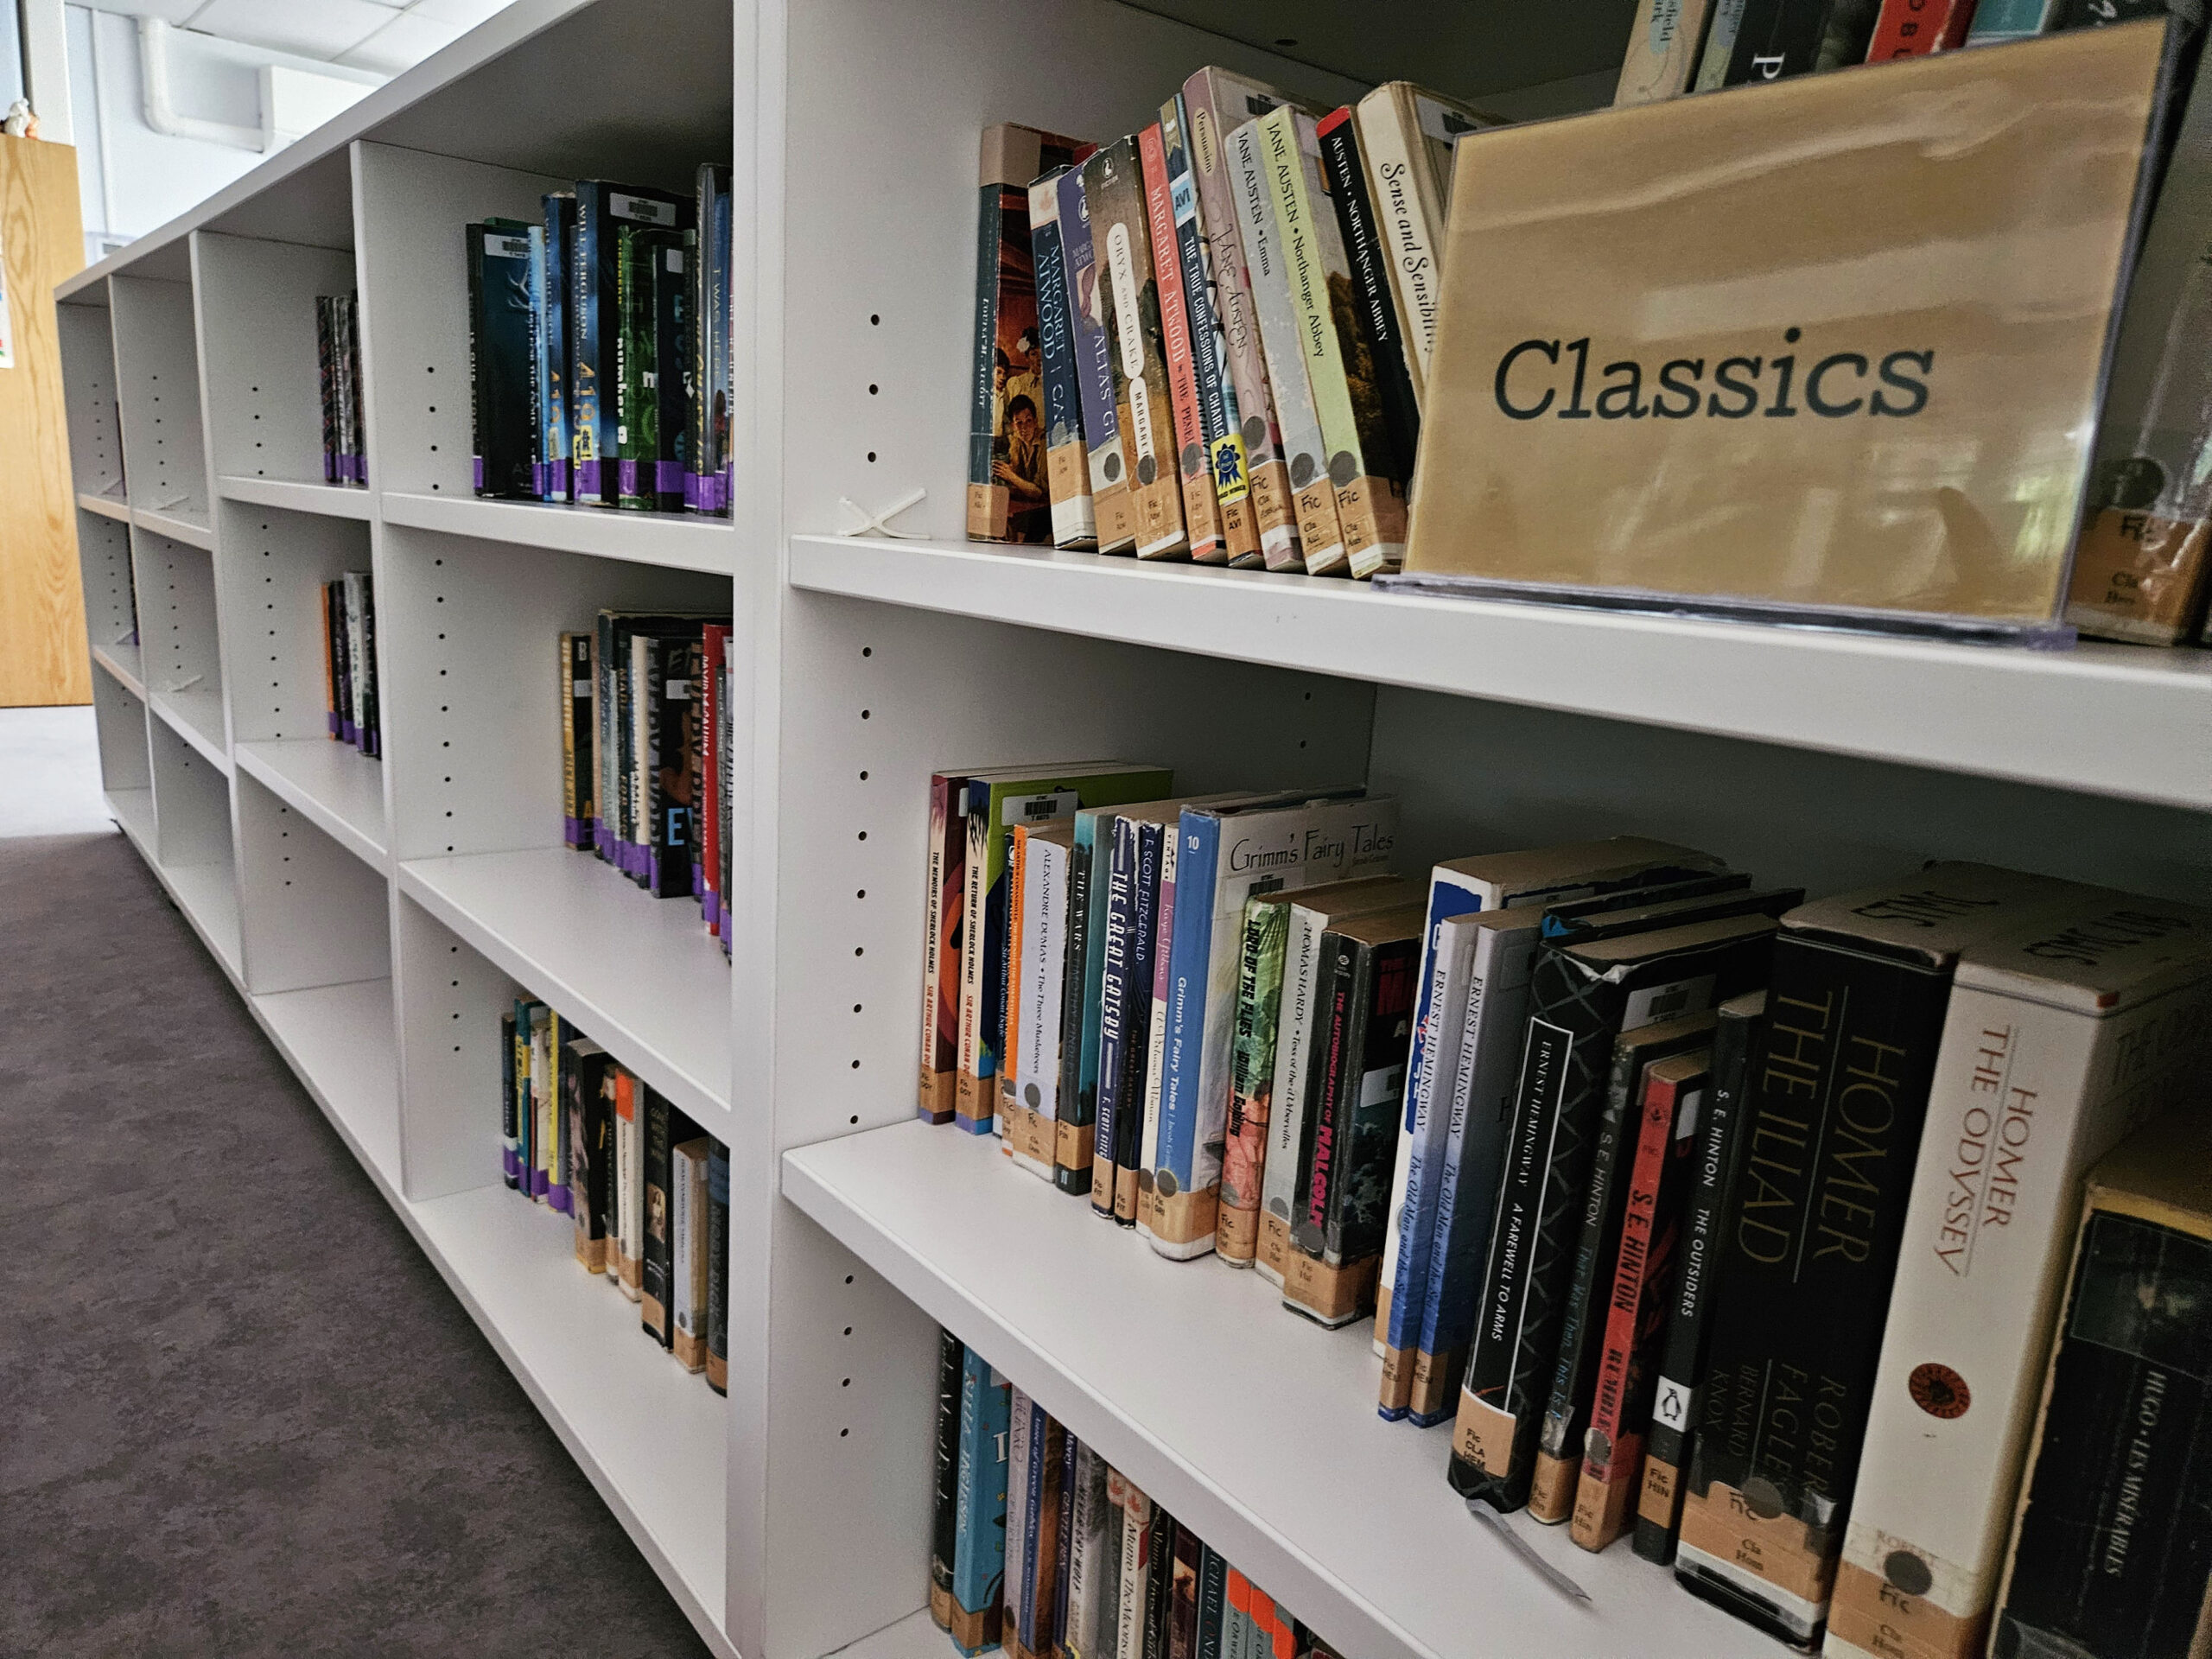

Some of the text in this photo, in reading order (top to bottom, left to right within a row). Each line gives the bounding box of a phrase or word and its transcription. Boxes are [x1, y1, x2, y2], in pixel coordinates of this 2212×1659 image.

[1195, 111, 1212, 173] Persuasion
[1175, 188, 1191, 210] AVI
[1237, 131, 1272, 276] JANE AUSTEN Emma
[1378, 159, 1416, 218] Sense
[1397, 218, 1422, 252] and
[1184, 236, 1198, 263] THE
[1267, 122, 1327, 358] JANE AUSTEN Northanger Abbey
[1331, 137, 1388, 341] AUSTEN NORTHANGER ABBEY
[578, 204, 588, 339] WILL FERGUSON
[1150, 186, 1185, 363] MARGARET ATWOOD
[1188, 263, 1203, 296] TRUE
[1037, 254, 1055, 359] ATWOOD
[1050, 245, 1065, 351] MARGARET
[1114, 234, 1127, 280] ORYX
[1124, 313, 1139, 369] CRAKE
[1193, 297, 1215, 372] CONFESSIONS
[580, 361, 595, 421] 419
[1094, 334, 1111, 401] ALIAS
[1205, 373, 1217, 388] OF
[1494, 327, 1936, 421] Classics
[1250, 474, 1268, 493] Fic
[1301, 494, 1322, 513] Fic
[1338, 490, 1360, 508] Fic
[1163, 834, 1172, 880] VINTAGE
[1187, 836, 1200, 851] 10
[1230, 823, 1394, 871] Grimm's Fairy Tales
[1141, 850, 1153, 887] SCOTT
[930, 899, 938, 909] OF
[969, 909, 977, 918] OF
[1073, 870, 1086, 950] THE WARS
[1135, 889, 1149, 963] FITZGERALD.
[1160, 903, 1173, 934] Kaye
[968, 920, 976, 955] SHERLOCK
[1033, 849, 1052, 1073] ALEXANDRE DUMAS The Three Musketeers
[1102, 872, 1128, 1039] THE GREAT GATSBY
[1294, 977, 1307, 1021] HARDY
[1427, 969, 1446, 1032] ERNEST
[1465, 976, 1483, 1039] ERNEST
[1168, 976, 1187, 1110] Grimm's Fairy Tales
[1225, 919, 1261, 1137] LORD OF THE FLIES William Golding
[1290, 1036, 1300, 1056] Tess
[1287, 1070, 1297, 1086] the
[1288, 1057, 1299, 1069] of
[1414, 1035, 1437, 1131] HEMINGWAY
[1309, 992, 1344, 1226] THE AUTOBIOGRAPHY OF MALCOLM
[1449, 1043, 1473, 1139] HEMINGWAY
[1101, 1106, 1110, 1130] SCOTT
[1737, 991, 1834, 1263] THE ILIAD
[1409, 1155, 1422, 1176] The
[1441, 1162, 1456, 1184] The
[1815, 1034, 1906, 1265] HOMER
[1934, 1025, 2012, 1277] THE ODYSSEY
[1984, 1085, 2038, 1227] HOMER
[1407, 1179, 1419, 1201] Old
[1438, 1186, 1452, 1209] Old
[1491, 1040, 1552, 1340] ERNEST HEMINGWAY A FAREWELL TO ARMS
[1585, 1167, 1605, 1227] HINTON
[1681, 1090, 1729, 1316] S. E. HINTON THE OUTSIDERS
[1221, 1214, 1235, 1229] Fic
[1268, 1220, 1282, 1237] Fic
[1403, 1202, 1416, 1231] Man
[1433, 1212, 1448, 1239] Man
[1399, 1234, 1411, 1258] and
[1428, 1241, 1443, 1267] and
[1613, 1190, 1653, 1313] S. E. HINTON
[1466, 1428, 1482, 1443] Fic
[2128, 1370, 2167, 1470] HUGO LES
[1465, 1440, 1485, 1458] CLA
[1649, 1468, 1669, 1484] Fic
[1060, 1491, 1070, 1539] GENTLE
[1125, 1523, 1136, 1571] Munro
[1072, 1557, 1082, 1592] WOLF
